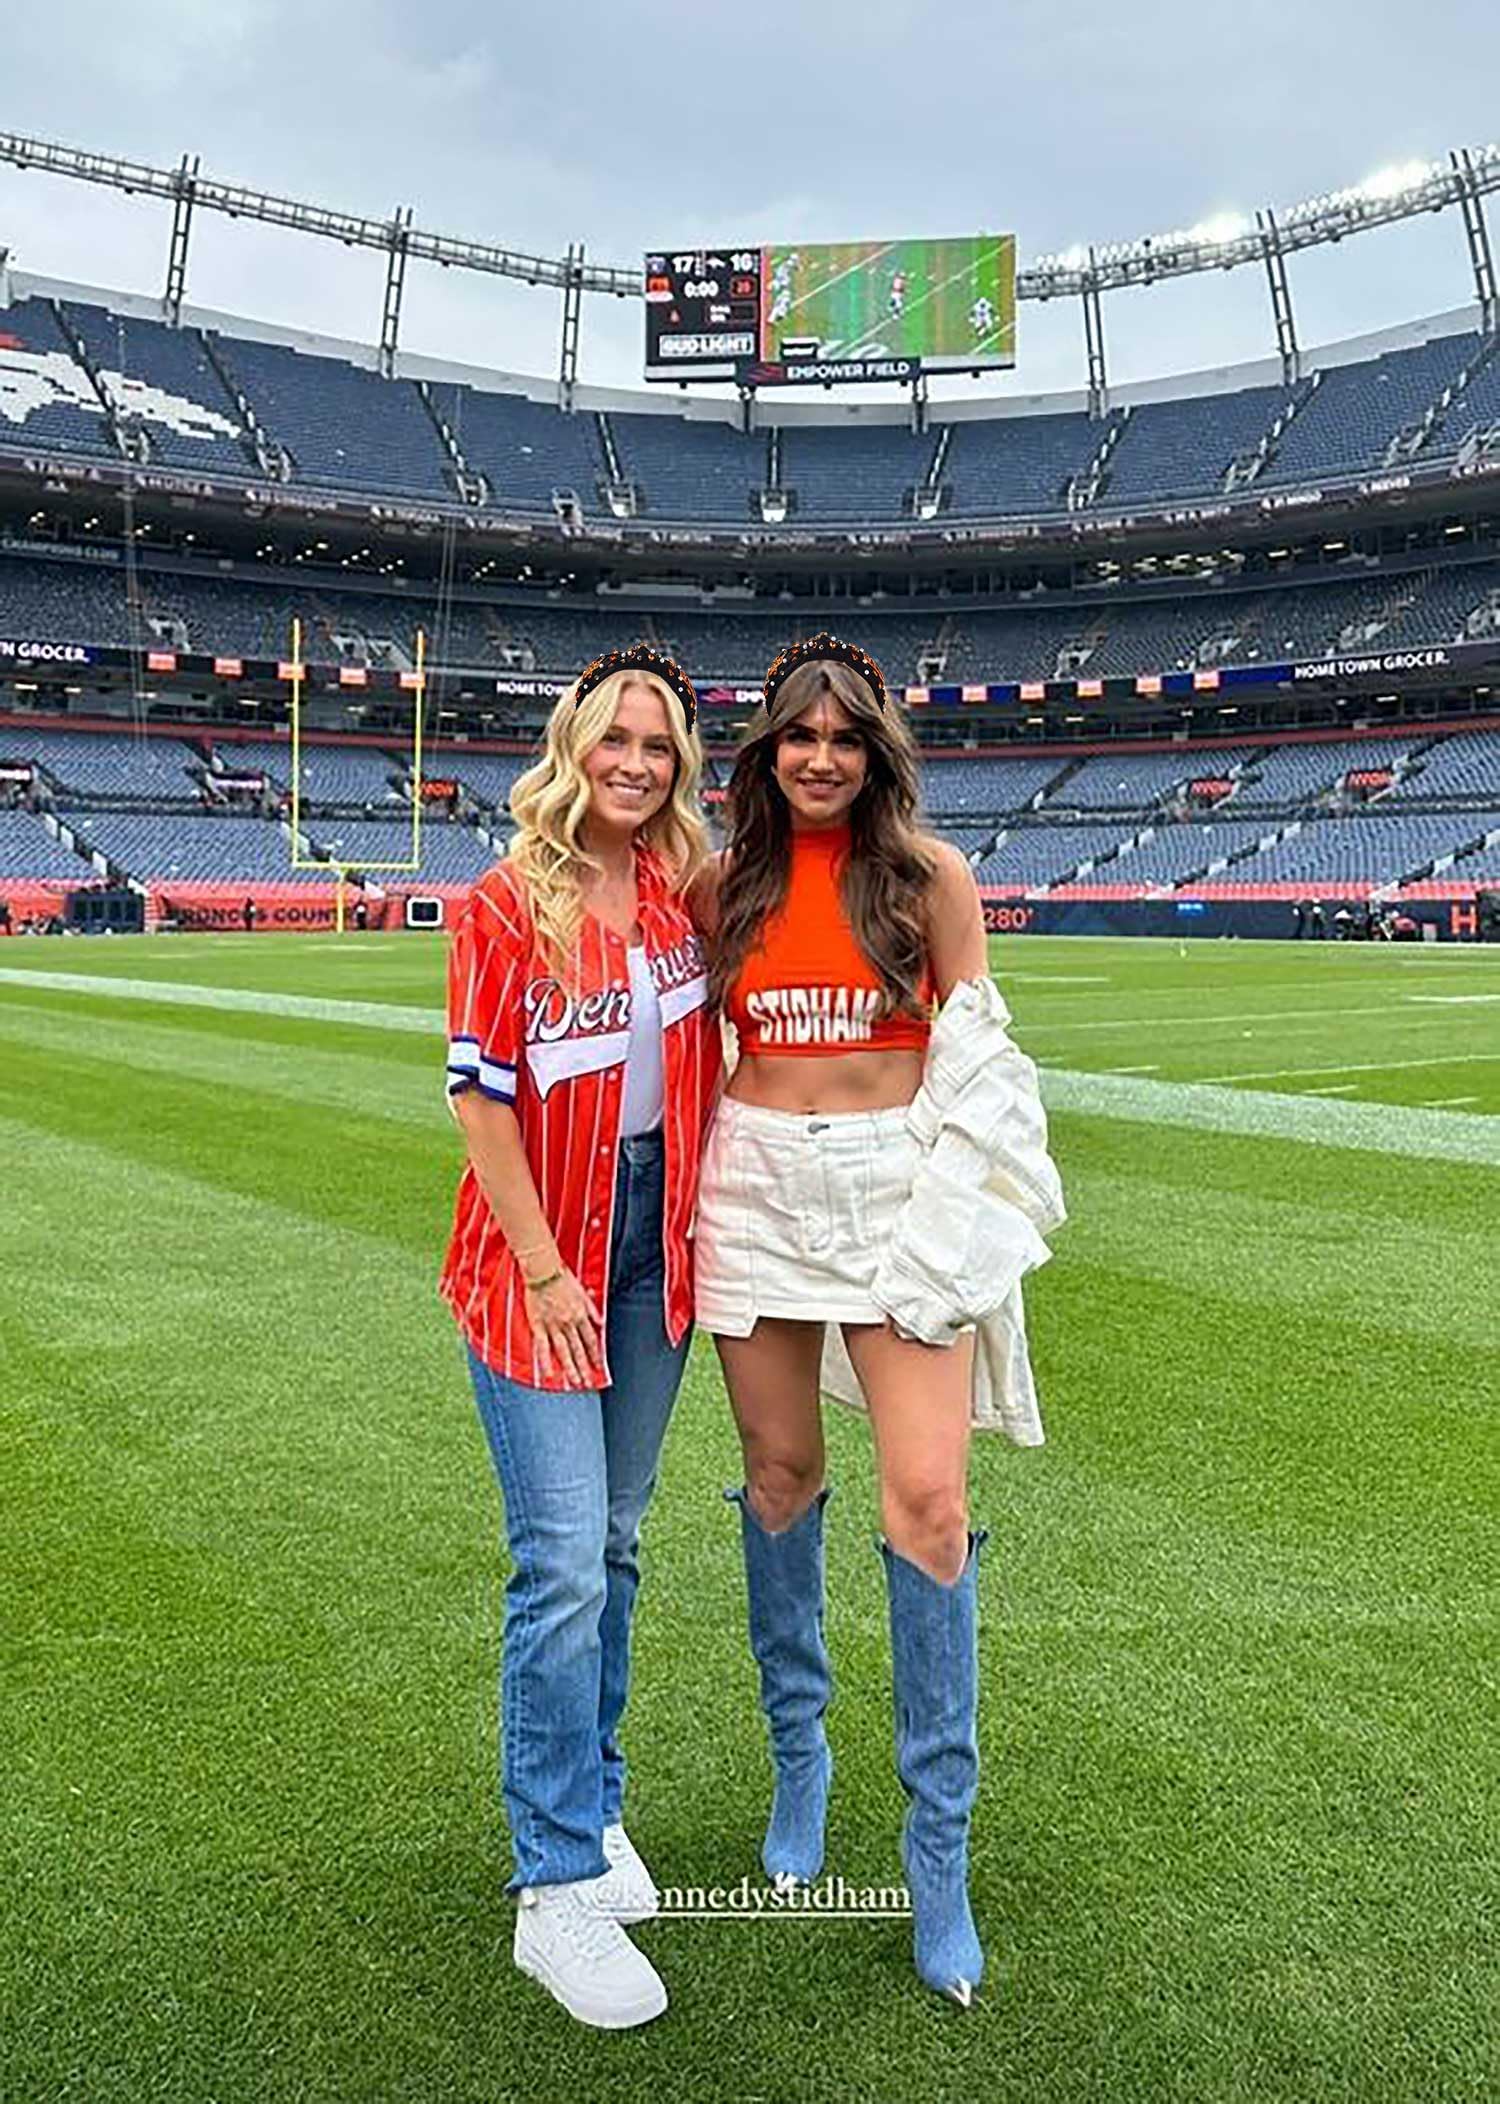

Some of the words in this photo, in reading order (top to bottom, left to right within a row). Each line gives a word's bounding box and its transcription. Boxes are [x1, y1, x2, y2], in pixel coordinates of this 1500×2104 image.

[672, 255, 694, 273] 17
[684, 280, 719, 299] 0:00
[787, 363, 864, 380] EMPOWER
[866, 361, 910, 377] FIELD
[746, 986, 880, 1045] STIDHAM
